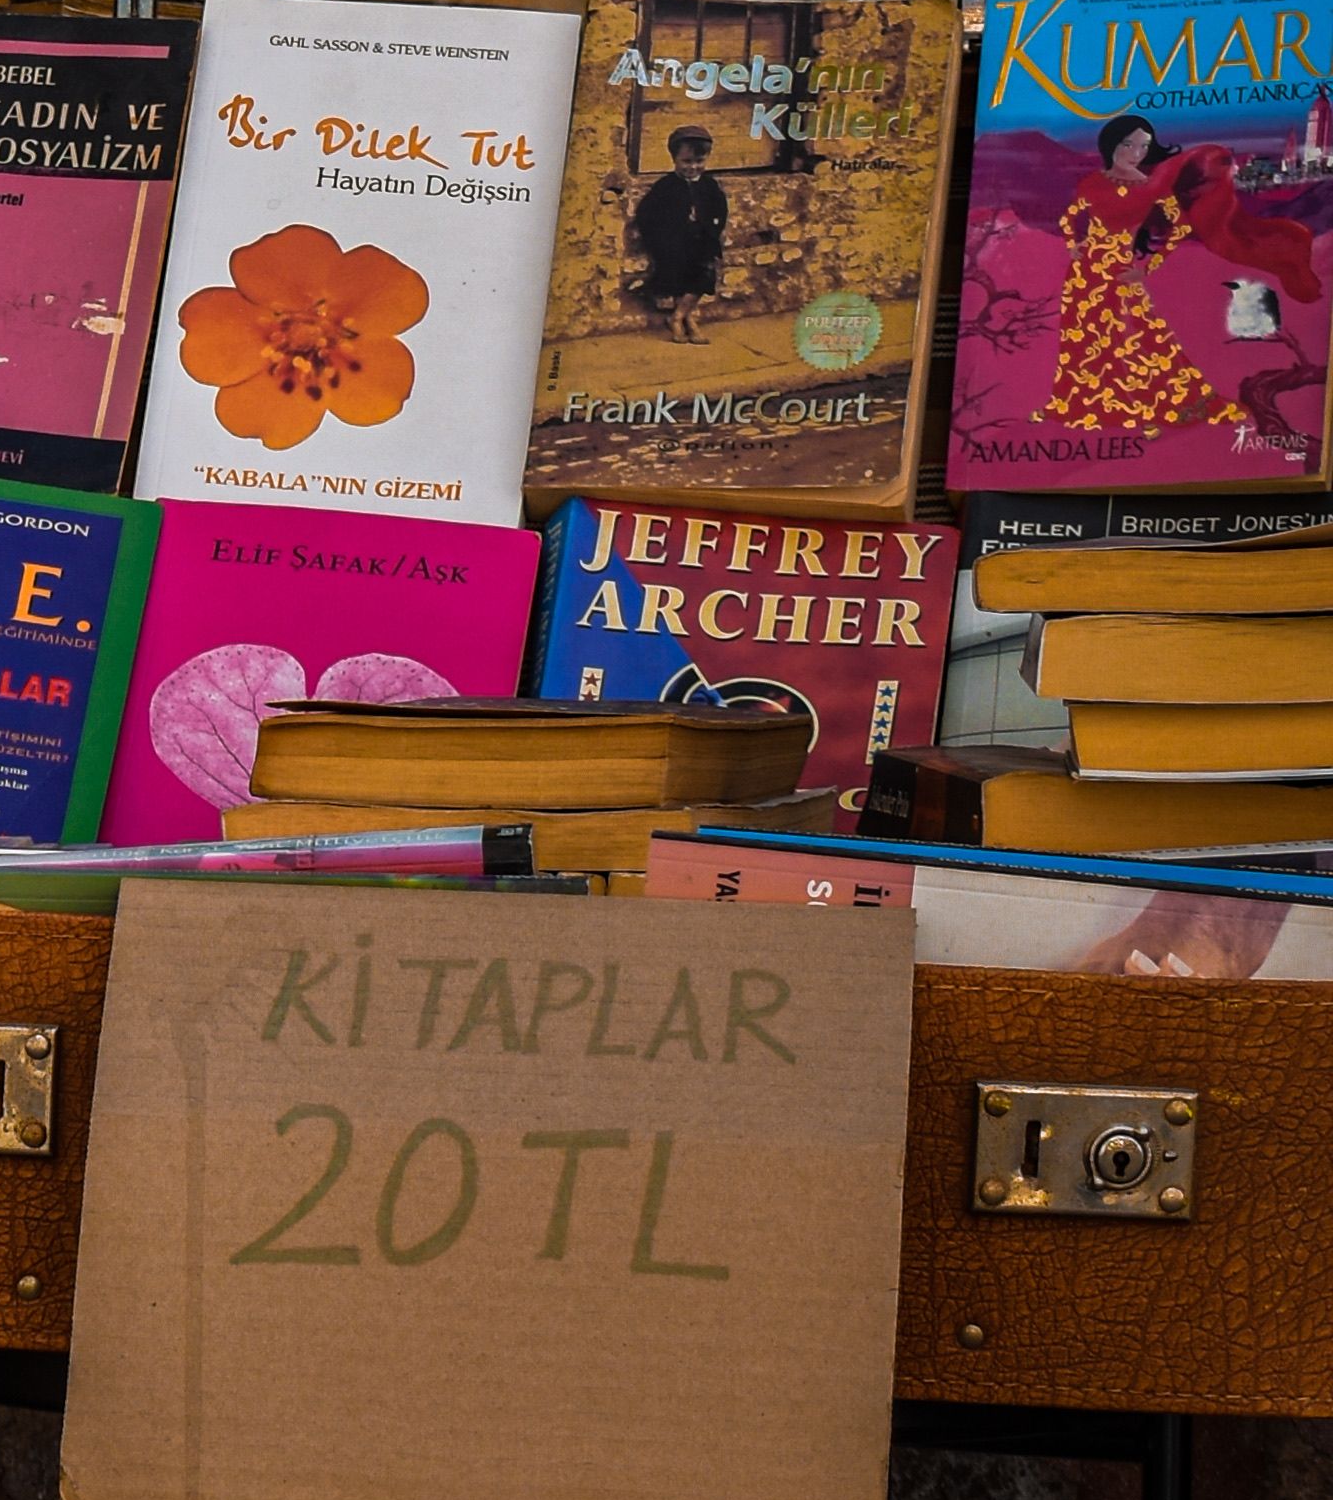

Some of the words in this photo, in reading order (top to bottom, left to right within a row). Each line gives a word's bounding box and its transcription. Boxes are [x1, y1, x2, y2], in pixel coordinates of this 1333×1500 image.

[269, 34, 309, 50] GAHL
[312, 39, 369, 54] SASSON
[372, 42, 384, 55] &
[387, 43, 432, 57] STEVE
[434, 45, 510, 62] WEINSTEIN
[1135, 86, 1230, 111] GOTHAM
[127, 103, 167, 131] VE
[749, 100, 914, 141] Külleri
[217, 94, 296, 151] Bir
[314, 116, 451, 171] Dilek
[461, 129, 535, 171] Tut
[315, 167, 416, 197] Hayatın
[424, 174, 532, 206] Değişsin
[548, 350, 562, 378] Baskı
[563, 390, 677, 425] Frank
[691, 391, 871, 424] McCourt
[968, 440, 1092, 464] AMANDA
[1097, 436, 1144, 460] LEES
[375, 477, 463, 502] GİZEMİ
[999, 520, 1083, 537] HELEN
[1121, 515, 1220, 534] BRIDGET
[579, 509, 942, 580] JEFFREY
[576, 580, 926, 647] ARCHER
[262, 932, 796, 1064] KİTAPLAR
